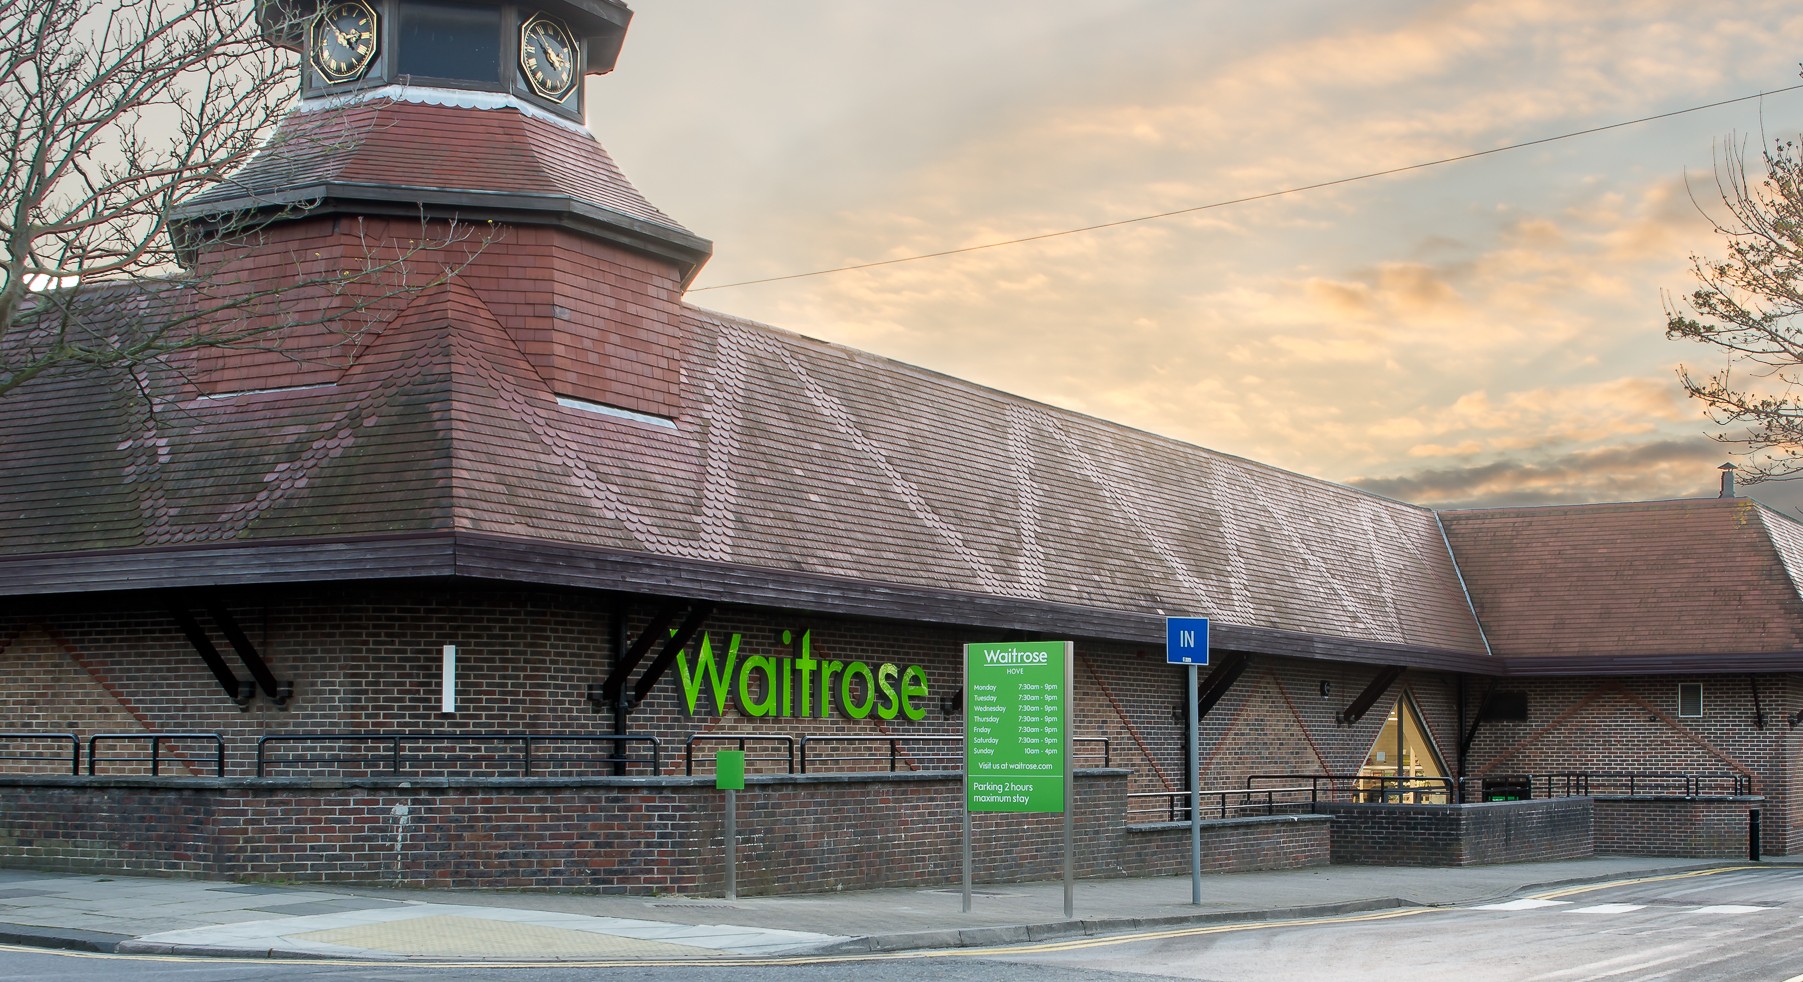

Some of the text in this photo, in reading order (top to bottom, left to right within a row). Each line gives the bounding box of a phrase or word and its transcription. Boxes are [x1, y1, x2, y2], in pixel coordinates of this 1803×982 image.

[1180, 630, 1194, 648] IN
[984, 648, 1048, 663] Waitrose
[669, 628, 929, 721] Waitrose
[973, 684, 997, 692] Monday
[1044, 684, 1058, 692] 9pm
[973, 695, 997, 703] Tuesday
[1044, 694, 1058, 702] 9pm
[973, 705, 1006, 714] Wednesday
[1044, 705, 1058, 713] 9pm
[973, 716, 999, 724] Thursday
[1044, 716, 1058, 724] 9pm
[973, 727, 991, 735] Friday
[1044, 726, 1058, 734] 9pm
[973, 737, 999, 745] Saturday
[1044, 737, 1058, 745] 9pm
[973, 747, 994, 756] Sunday
[1044, 748, 1058, 756] 4pm
[979, 761, 992, 769] Visit
[1009, 762, 1053, 770] waitrose.com
[973, 782, 1033, 793] Parking 2 hours
[973, 793, 1030, 805] maximum stay
